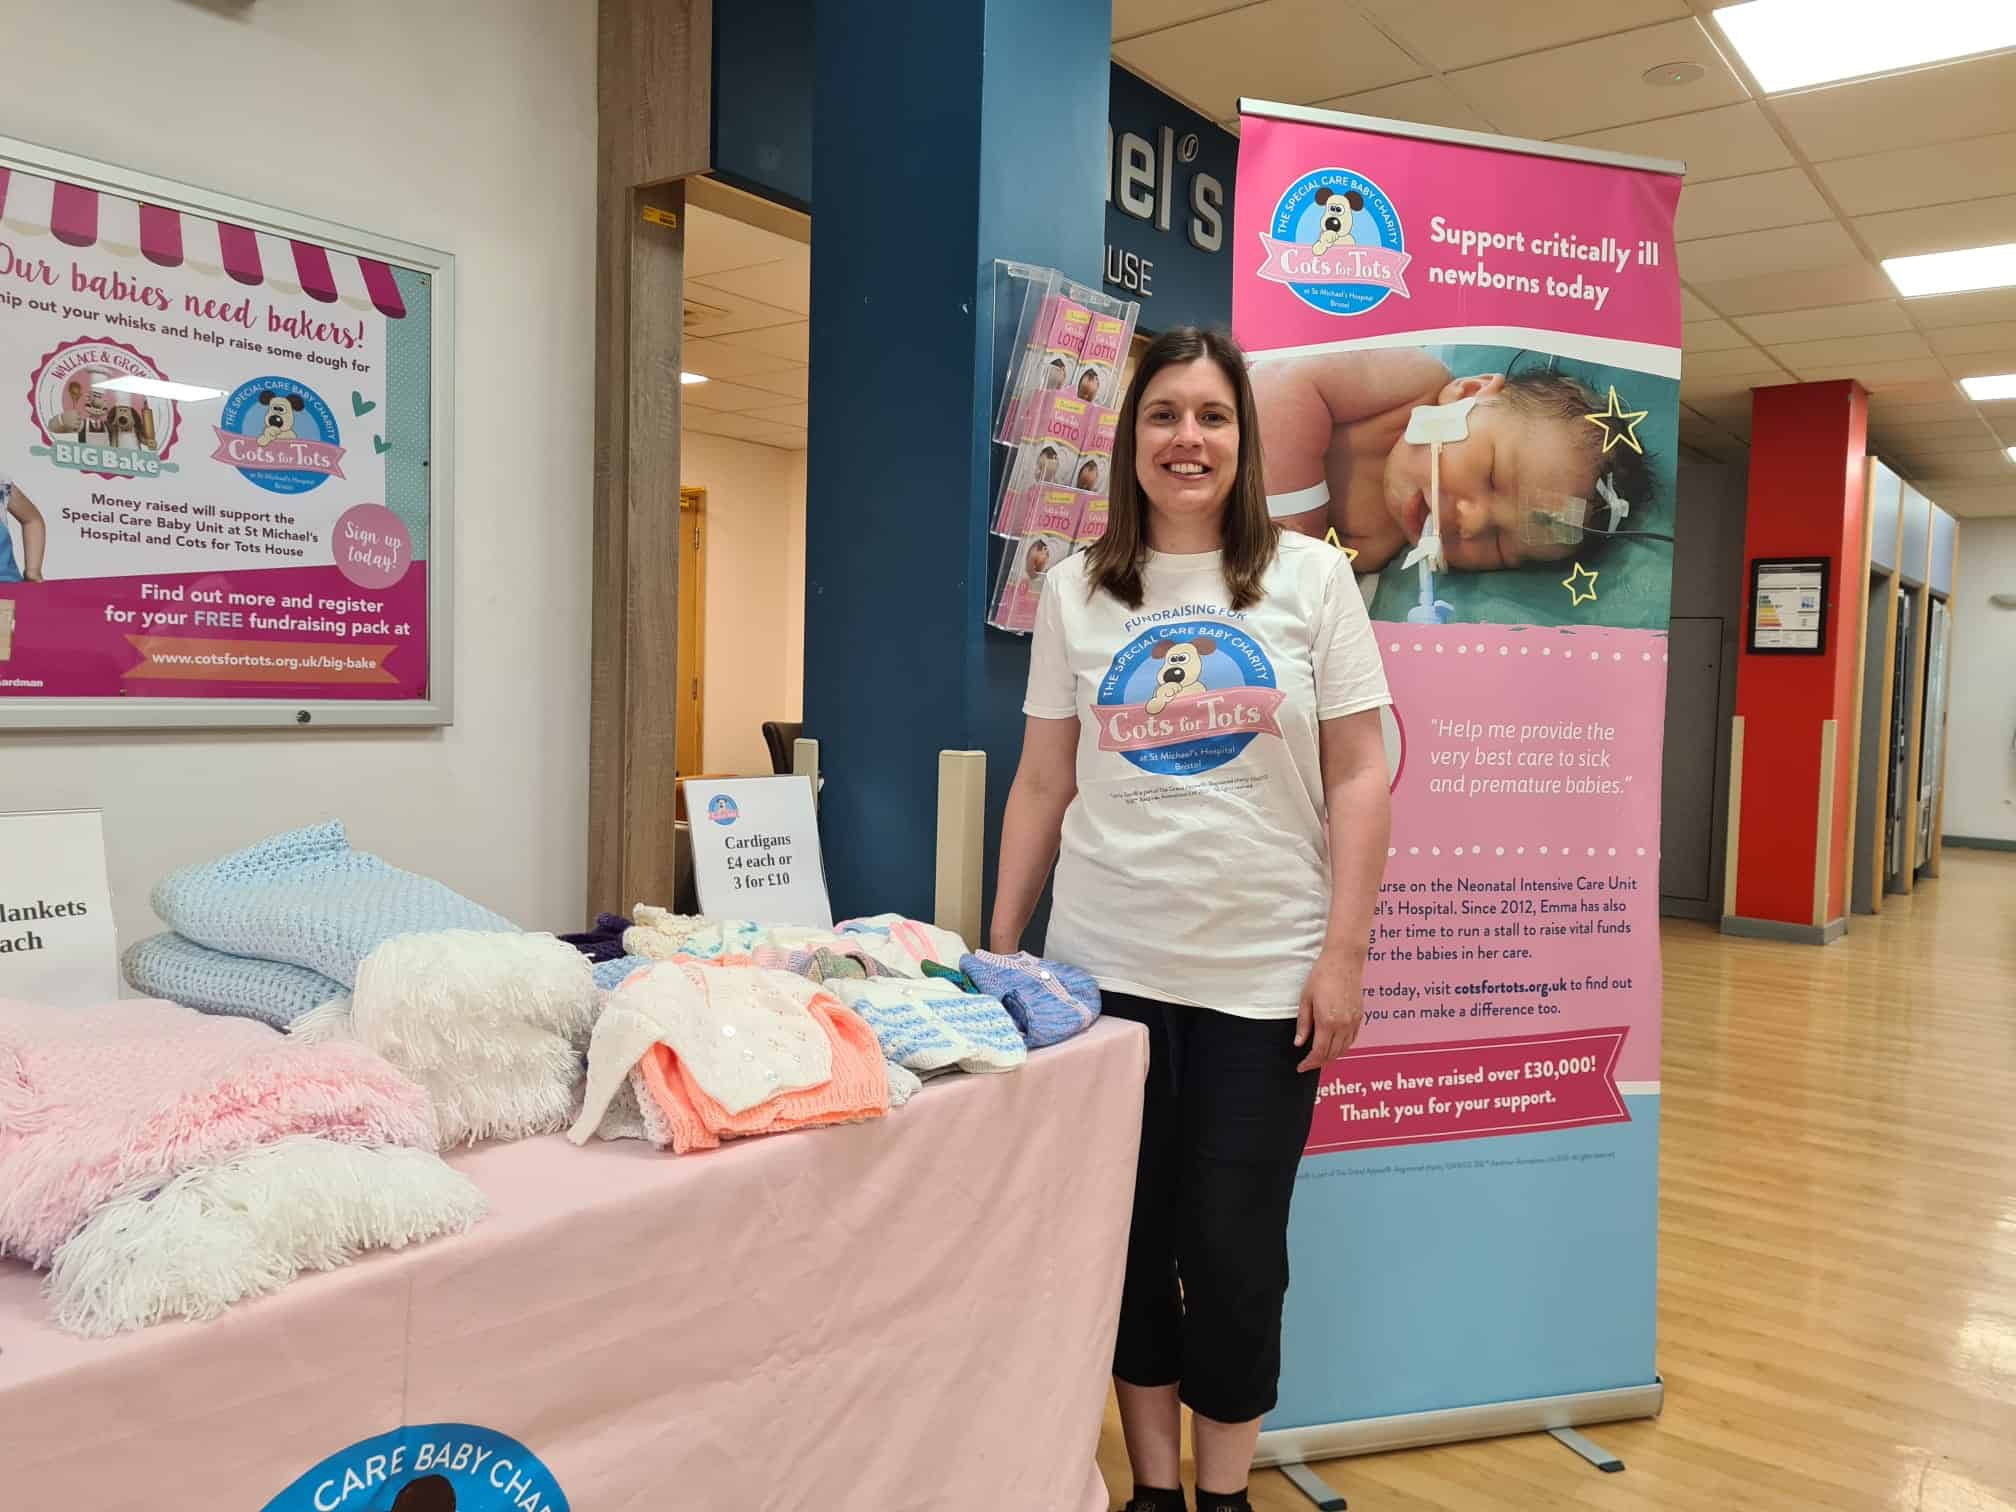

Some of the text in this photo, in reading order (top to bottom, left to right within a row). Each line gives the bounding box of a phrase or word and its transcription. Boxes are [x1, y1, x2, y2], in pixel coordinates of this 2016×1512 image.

[1285, 176, 1397, 243] SPECIAL CARE BABY CHARITY
[1430, 216, 1659, 273] Support critically ill
[1280, 249, 1392, 279] Cots for Tots
[0, 242, 364, 349] Our babies need bakers!
[1429, 261, 1609, 311] newborns today
[28, 299, 57, 313] out
[62, 305, 100, 319] your
[105, 312, 156, 332] whisks
[161, 325, 188, 340] and
[193, 328, 225, 347] help
[229, 337, 263, 352] raise
[267, 345, 303, 360] some
[306, 351, 348, 370] dough
[352, 359, 370, 373] for
[1089, 343, 1117, 360] LOTTO
[264, 381, 289, 391] CARE
[1048, 420, 1080, 440] LOTTO
[56, 443, 160, 473] BIG Bake
[228, 440, 331, 468] Cots Tots
[91, 493, 295, 525] Money raised will support the
[62, 508, 319, 543] Special Care Baby Unit at St Michael's
[344, 520, 401, 549] Sign up
[80, 527, 304, 557] Hospital and Cots for Tots House
[348, 546, 400, 573] today!
[141, 583, 384, 614] Find out more and register
[104, 605, 410, 636] for your FREE fundraising pack at
[1124, 604, 1216, 632] FUNDRAISING
[152, 652, 377, 670] www.cotsfortots.org.uk/big-bake
[1115, 627, 1270, 680] SPECIAL CARE BABY CHARITY
[1108, 696, 1260, 743] Cots for Tots
[1431, 719, 1615, 744] "Help me provide the
[1430, 747, 1610, 767] very best care to sick
[1430, 776, 1465, 793] and
[1470, 776, 1561, 797] premature
[725, 834, 791, 850] Cardigans
[728, 853, 792, 870] £4 each or
[733, 872, 790, 890] 3 for £10
[1410, 882, 1426, 893] on
[1431, 879, 1452, 893] the
[1457, 878, 1516, 892] Neonatal
[1521, 877, 1573, 891] Intensive
[1577, 877, 1604, 891] Care
[1608, 876, 1637, 890] Unit
[1398, 899, 1626, 919] Hospital. Since 2012, Emma has also
[1380, 920, 1632, 938] her time to run stall to raise vital funds
[1367, 945, 1532, 961] for the babies in her care.
[1379, 977, 1633, 1000] today, visit cotsfortots.org.uk to find out
[1364, 1003, 1561, 1025] you can make difference too.
[1371, 1078, 1392, 1092] we
[1396, 1073, 1433, 1090] have
[1438, 1066, 1484, 1086] raised
[1488, 1068, 1519, 1082] over
[1524, 1055, 1596, 1080] £30,000!
[1339, 1089, 1556, 1123] Thank you for your support.
[313, 1446, 407, 1512] CARE
[414, 1442, 492, 1475] BABY
